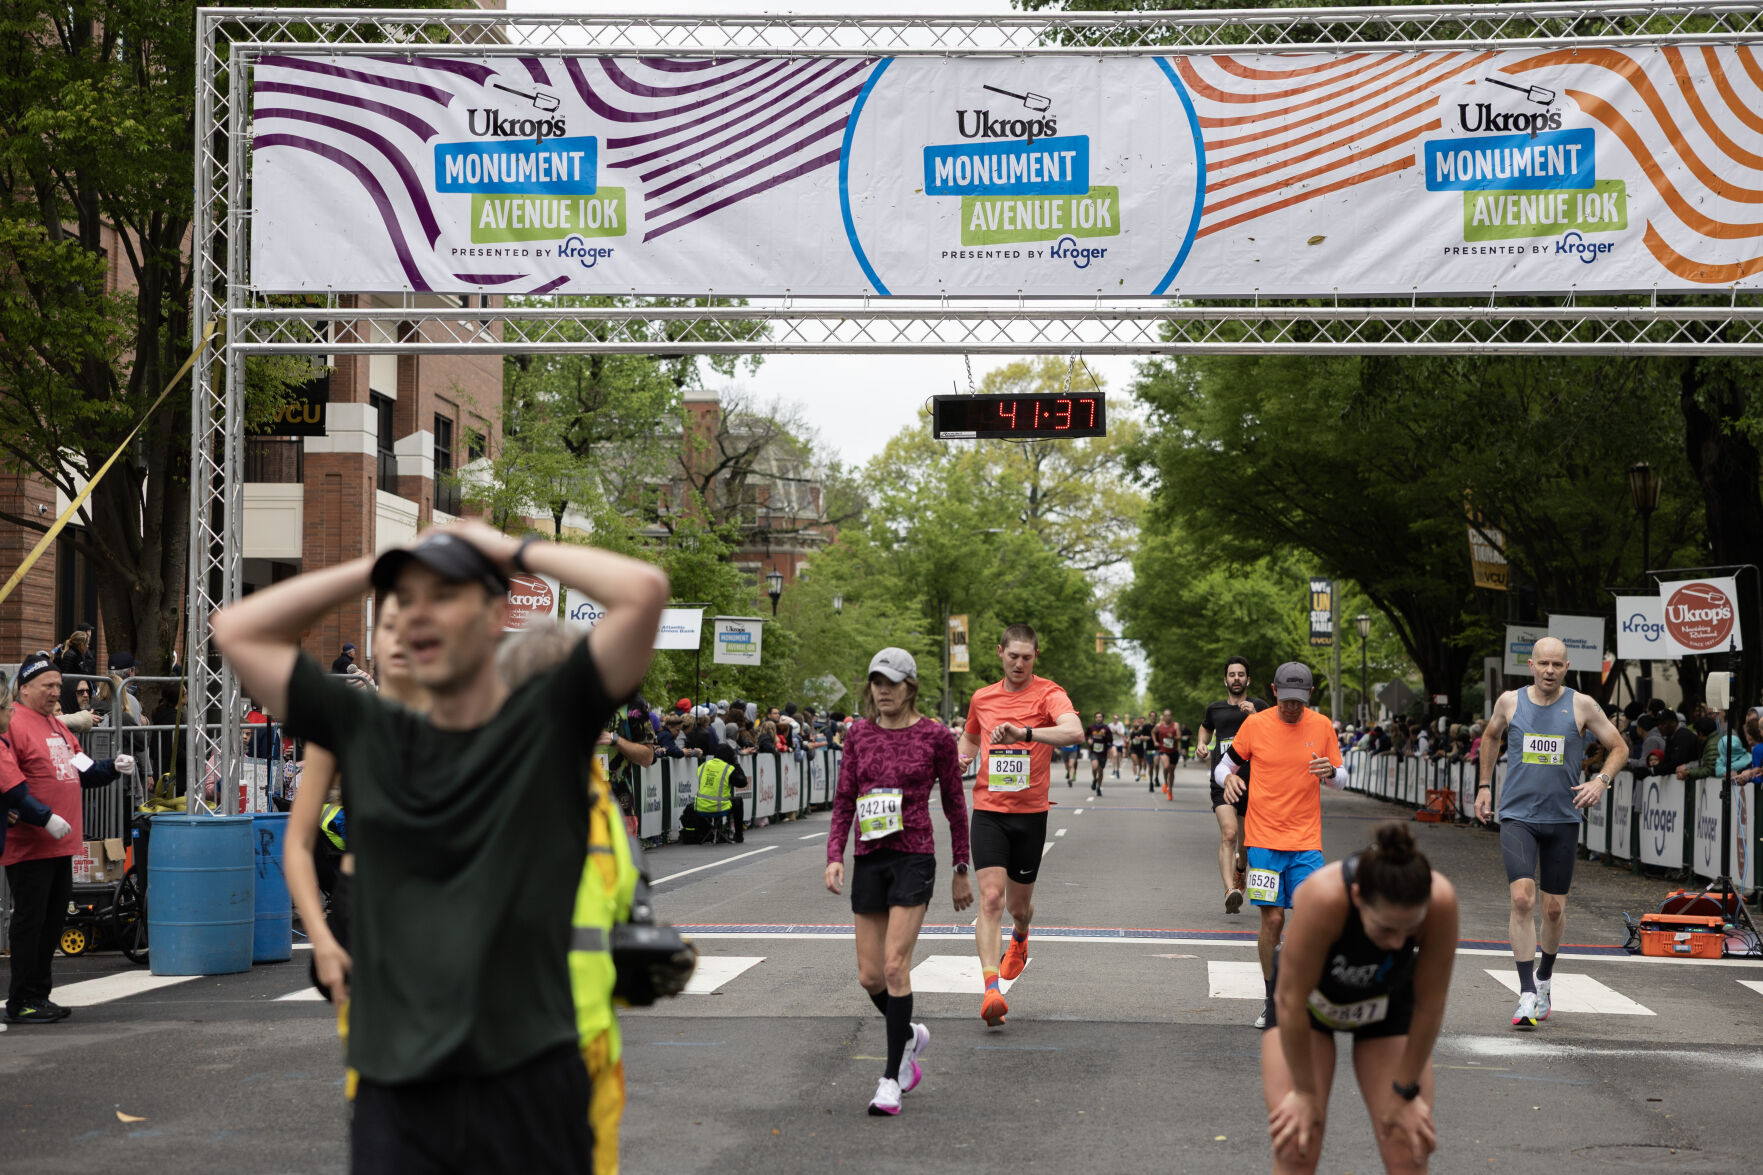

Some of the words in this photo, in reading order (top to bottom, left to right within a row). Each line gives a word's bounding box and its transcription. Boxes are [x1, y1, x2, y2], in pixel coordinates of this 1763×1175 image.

[467, 109, 566, 145] Ukrop's
[956, 110, 1057, 146] Ukrop's
[1458, 103, 1562, 140] Ukrop's
[445, 151, 586, 184] MONUMENT
[935, 151, 1076, 186] MONUMENT
[1436, 144, 1581, 182] MONUMENT
[479, 199, 571, 229] AVENUE
[579, 197, 618, 228] 10K
[970, 199, 1063, 230] AVENUE
[1071, 198, 1111, 228] 10K
[1472, 193, 1568, 226] AVENUE
[1577, 192, 1618, 223] 10K
[451, 247, 529, 257] PRESENTED
[536, 247, 552, 257] BY
[558, 236, 614, 268] Kroger
[942, 250, 1020, 259] PRESENTED
[1028, 250, 1043, 259] BY
[1050, 237, 1107, 268] Kroger
[1444, 246, 1524, 255] PRESENTED
[1533, 245, 1549, 254] BY
[1555, 232, 1614, 264] Kroger
[508, 590, 551, 609] krop's
[1667, 604, 1731, 625] Ukrop's
[1530, 739, 1557, 752] 4009
[996, 760, 1022, 773] 8250
[860, 799, 896, 818] 24210
[1643, 782, 1677, 857] Kroger
[1697, 788, 1718, 867] Kroger
